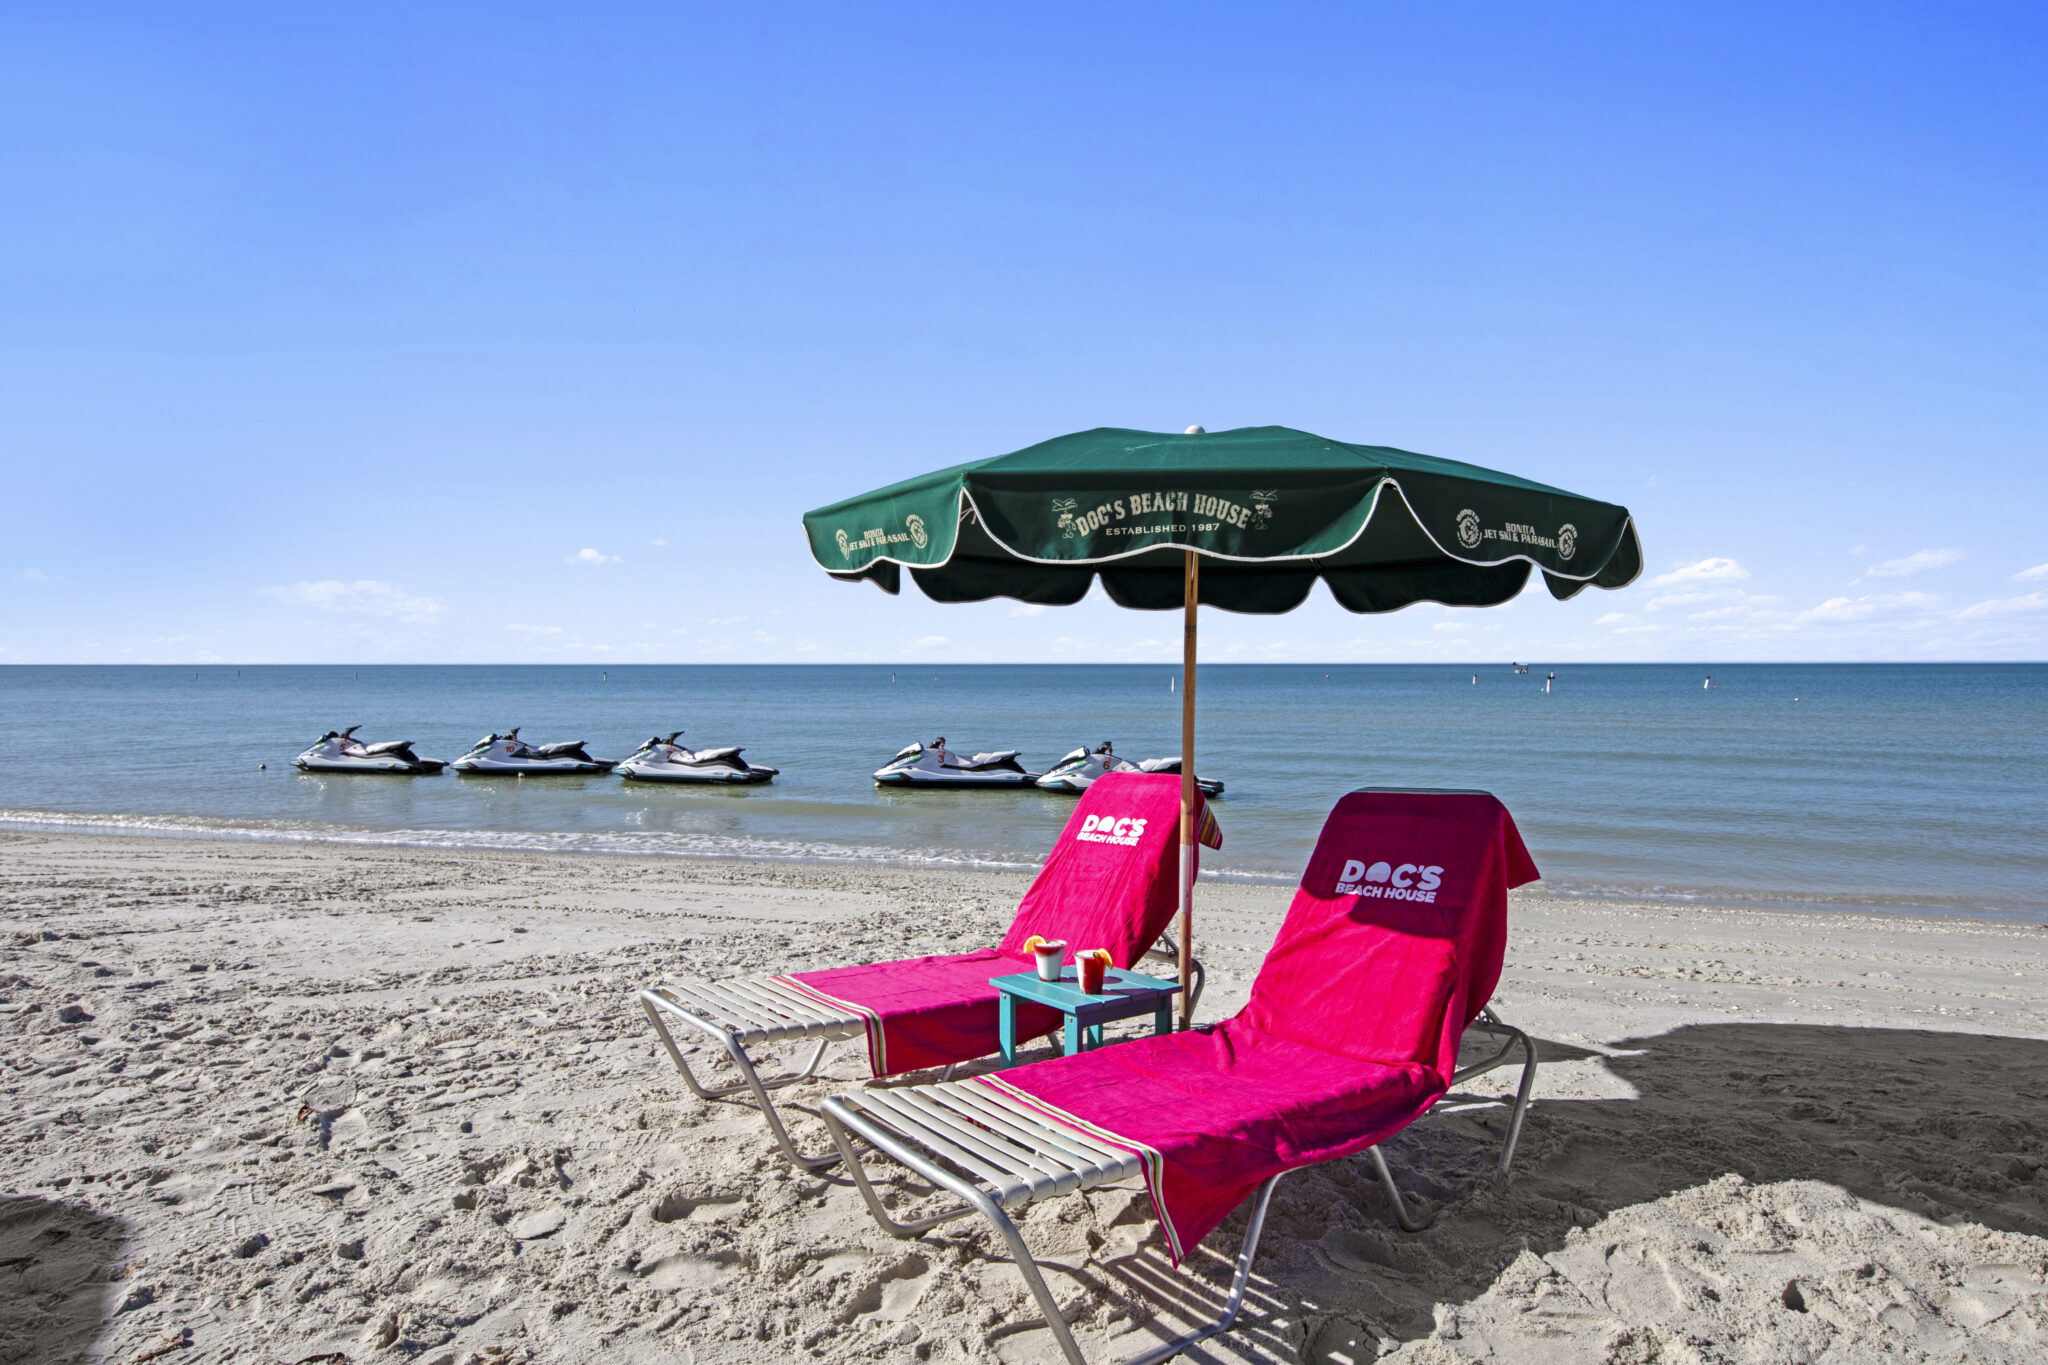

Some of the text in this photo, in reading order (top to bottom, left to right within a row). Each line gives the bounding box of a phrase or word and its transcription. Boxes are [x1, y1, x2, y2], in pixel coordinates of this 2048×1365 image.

[1075, 491, 1252, 537] DOC'S BEACH HOUSE
[1106, 522, 1220, 536] ESTABLISHED 1987
[1505, 522, 1536, 536] BONITA
[1483, 529, 1498, 540] JET
[1498, 530, 1512, 542] SKI
[1521, 533, 1558, 549] PARASAIL
[849, 541, 859, 552] JET
[505, 745, 515, 753] 10
[937, 754, 945, 764] 3
[1102, 760, 1111, 771] 6
[1080, 814, 1148, 837] DOC'S
[1076, 832, 1140, 847] BEACH HOUSE
[1338, 859, 1445, 891] DOC'S
[1335, 882, 1438, 904] BEACH HOUSE
